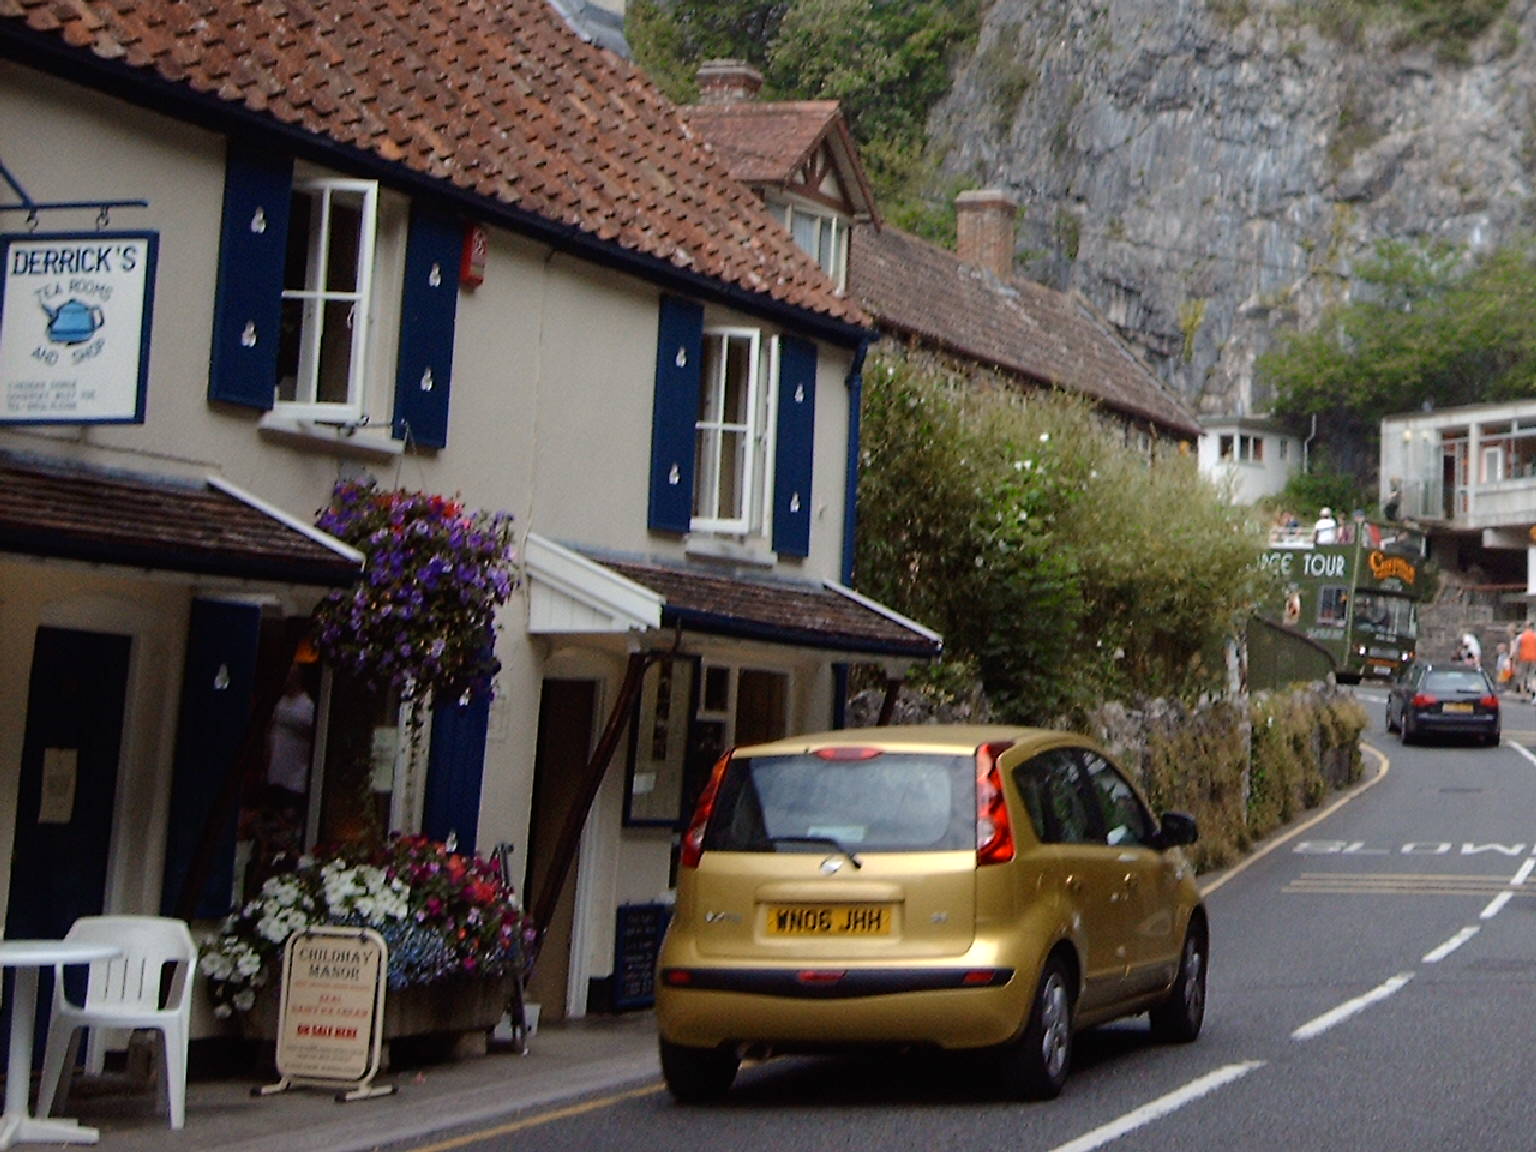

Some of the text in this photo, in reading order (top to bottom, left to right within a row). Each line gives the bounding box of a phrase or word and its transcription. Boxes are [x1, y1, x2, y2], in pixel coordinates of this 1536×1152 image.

[12, 246, 136, 275] DERRICK'S
[33, 278, 113, 302] TEA ROOMS
[32, 338, 105, 365] AND SHOP
[1303, 553, 1345, 577] TOUR
[777, 909, 882, 931] WN06 JHH
